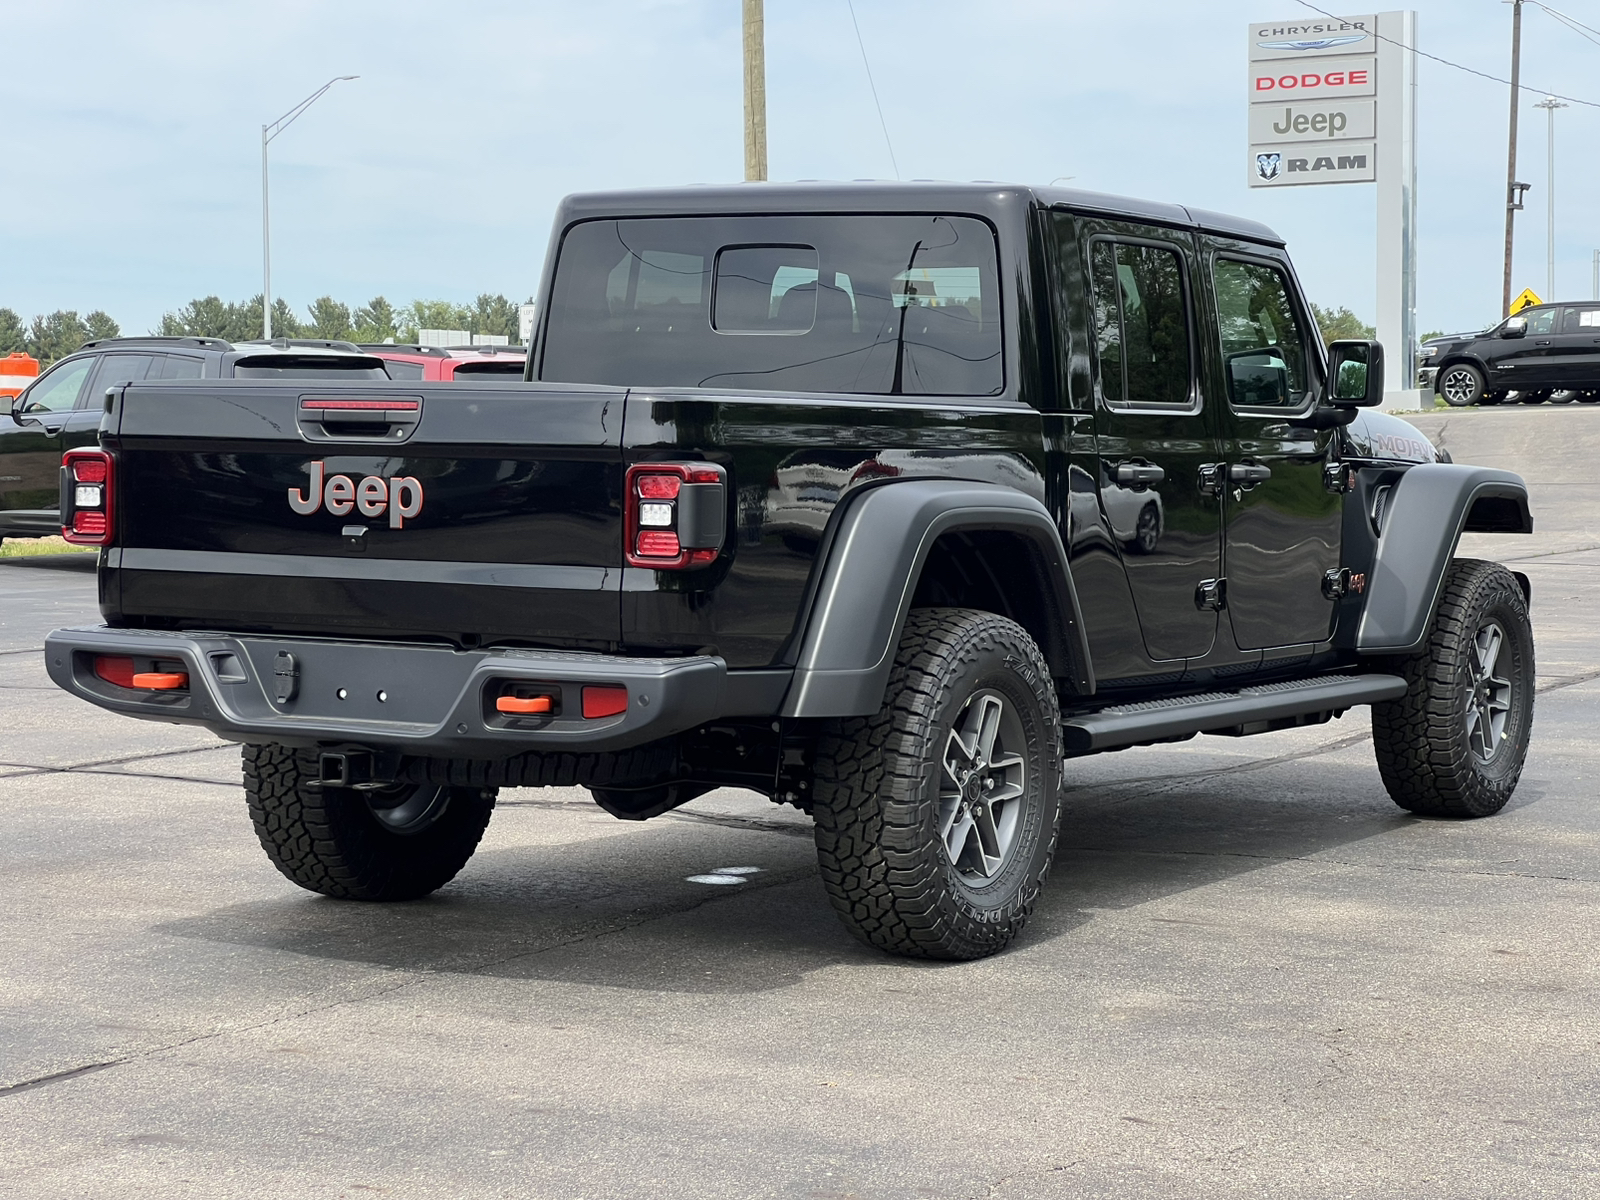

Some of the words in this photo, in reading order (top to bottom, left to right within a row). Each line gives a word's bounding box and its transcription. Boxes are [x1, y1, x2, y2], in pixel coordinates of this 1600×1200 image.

[1258, 22, 1365, 37] CHRYSLER
[1256, 70, 1368, 91] DODGE
[1273, 107, 1347, 137] Jeep
[1287, 155, 1367, 172] RAM
[288, 460, 424, 529] Jeep
[1350, 574, 1364, 593] eep
